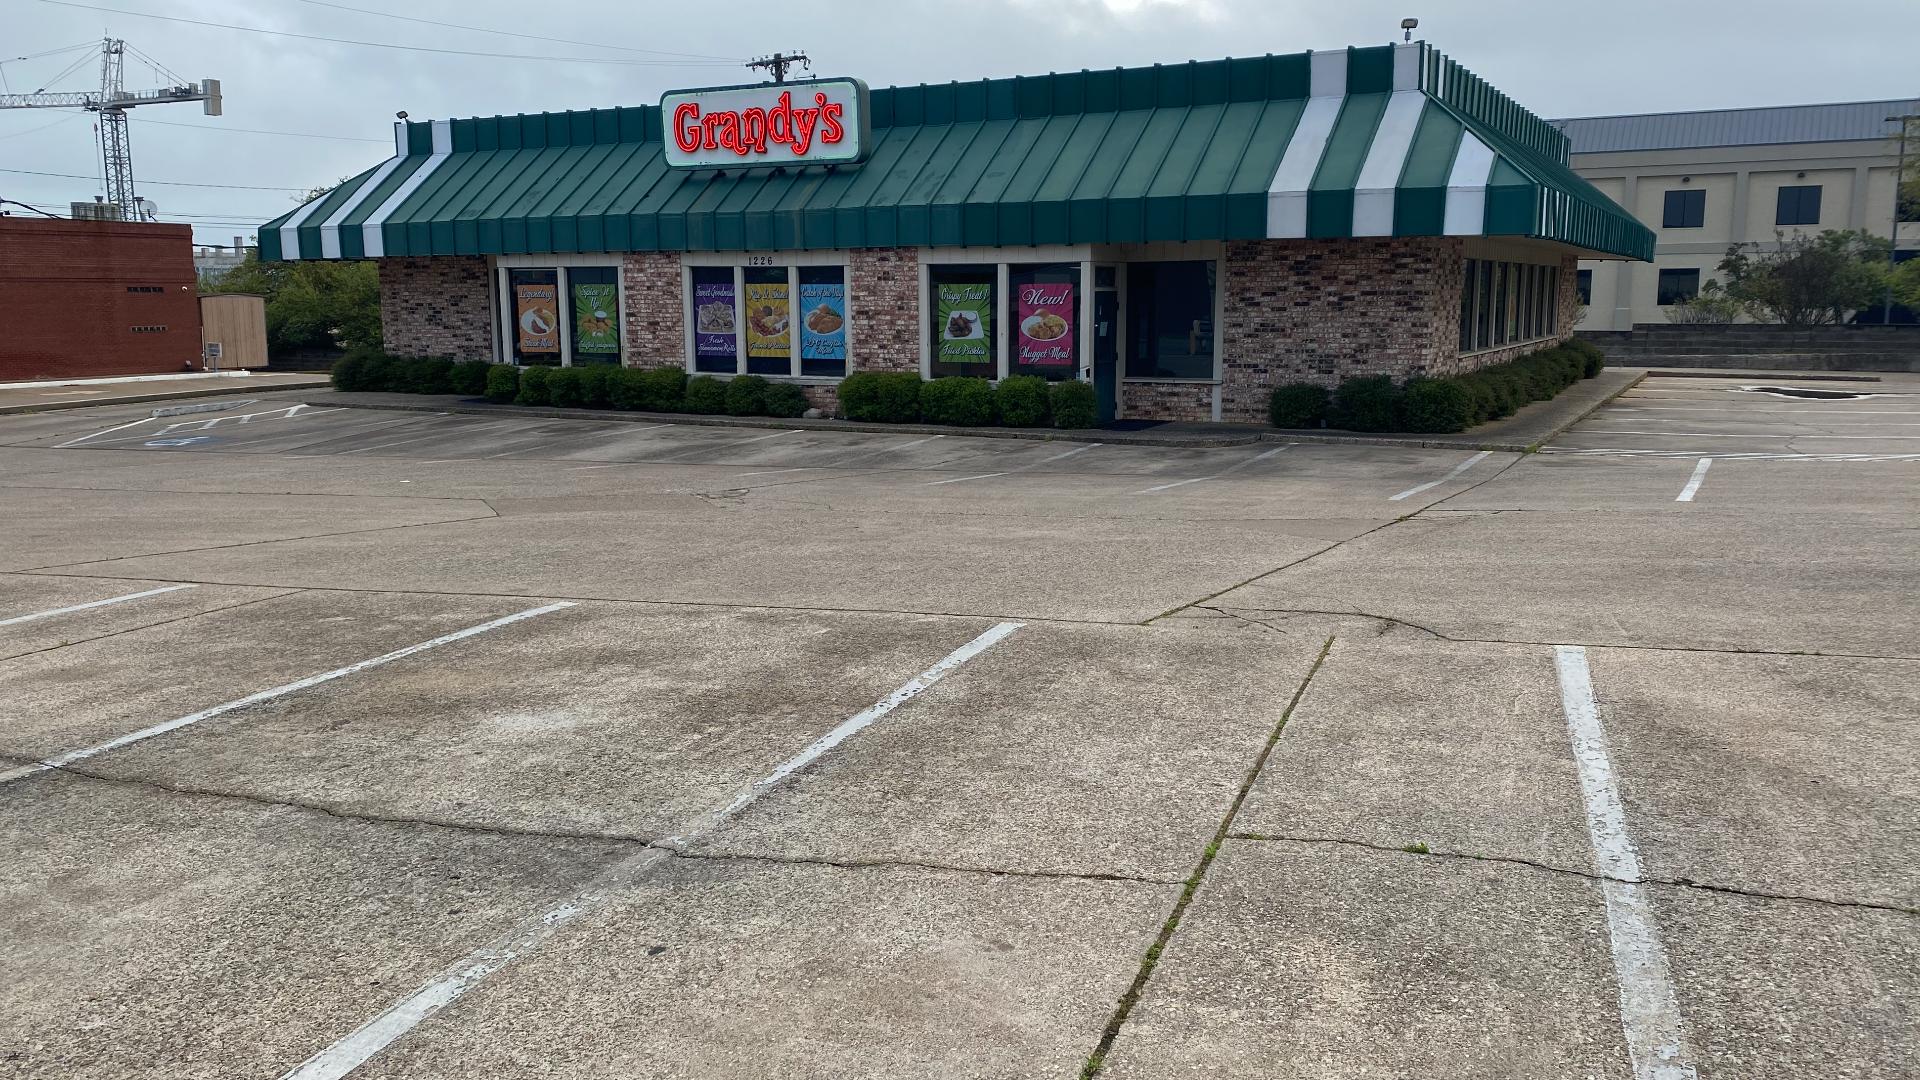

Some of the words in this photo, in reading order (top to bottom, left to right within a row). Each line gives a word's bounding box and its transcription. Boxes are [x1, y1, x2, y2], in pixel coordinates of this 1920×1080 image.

[673, 91, 844, 156] Grandy's
[749, 256, 773, 265] 1226
[1022, 289, 1069, 305] New!
[1020, 346, 1048, 363] Nugget
[1049, 346, 1070, 359] Meal
